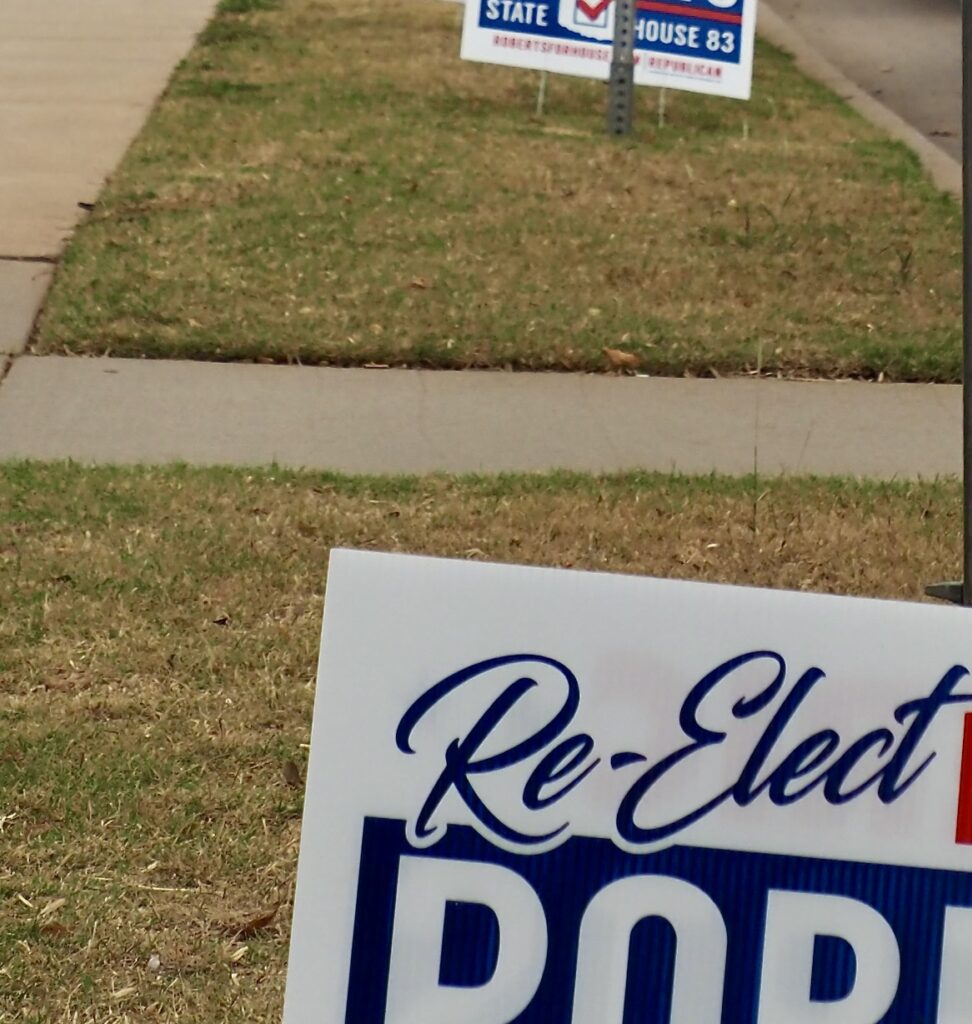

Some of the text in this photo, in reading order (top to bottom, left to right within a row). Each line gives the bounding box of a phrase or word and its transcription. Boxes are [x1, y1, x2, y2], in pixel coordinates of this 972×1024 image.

[492, 34, 723, 78] ROBERTSFORHOUSE REPUBLICAN
[706, 29, 736, 54] 83
